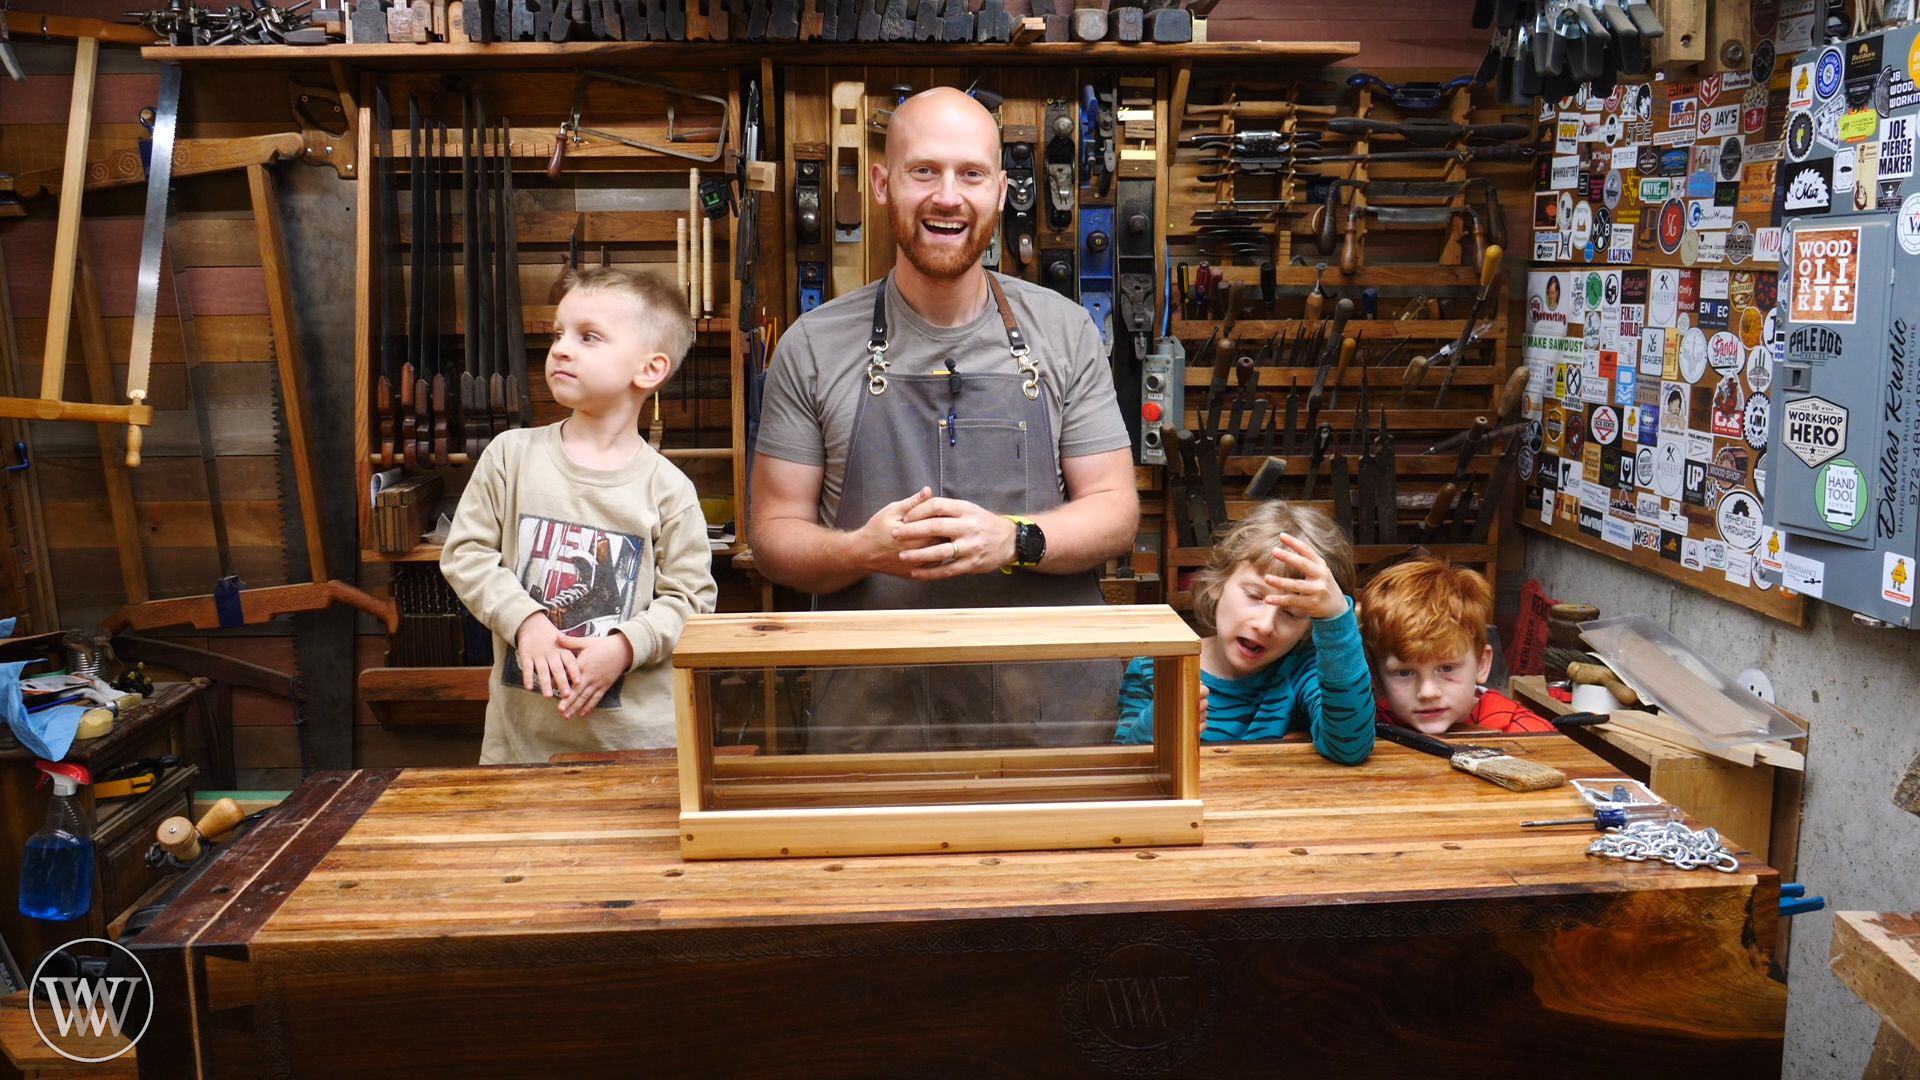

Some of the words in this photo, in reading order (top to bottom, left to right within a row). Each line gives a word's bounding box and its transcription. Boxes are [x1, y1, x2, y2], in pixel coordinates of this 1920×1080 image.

[1890, 71, 1901, 83] JB
[1889, 80, 1914, 95] WOOD
[1889, 93, 1920, 108] WORKIN
[1715, 109, 1737, 126] JAY'S
[1888, 119, 1906, 140] JOE
[1881, 139, 1912, 157] PIERCE
[1878, 157, 1912, 175] MAKER
[1643, 182, 1661, 195] WAYNE
[1797, 239, 1852, 258] WOOD
[1680, 270, 1691, 278] Not
[1679, 285, 1693, 296] Only
[1621, 305, 1631, 321] FIX
[1678, 301, 1695, 311] Wood
[1620, 321, 1639, 337] BUILD
[1528, 336, 1547, 349] MAKE
[1548, 338, 1583, 353] SAWDUST
[1789, 327, 1818, 354] PALE
[1819, 328, 1843, 356] DOG
[1885, 317, 1907, 423] Rustic
[1788, 410, 1843, 426] WORKSHOP
[1790, 422, 1839, 447] HERO
[1686, 464, 1704, 491] UP
[1709, 466, 1725, 477] WOOD
[1726, 470, 1741, 481] SHOP
[1828, 476, 1856, 490] HAND
[1877, 429, 1900, 540] Dallas
[1827, 488, 1855, 503] TOOL
[1724, 513, 1756, 530] ASHEVILLE
[1723, 523, 1756, 540] HARDWARE
